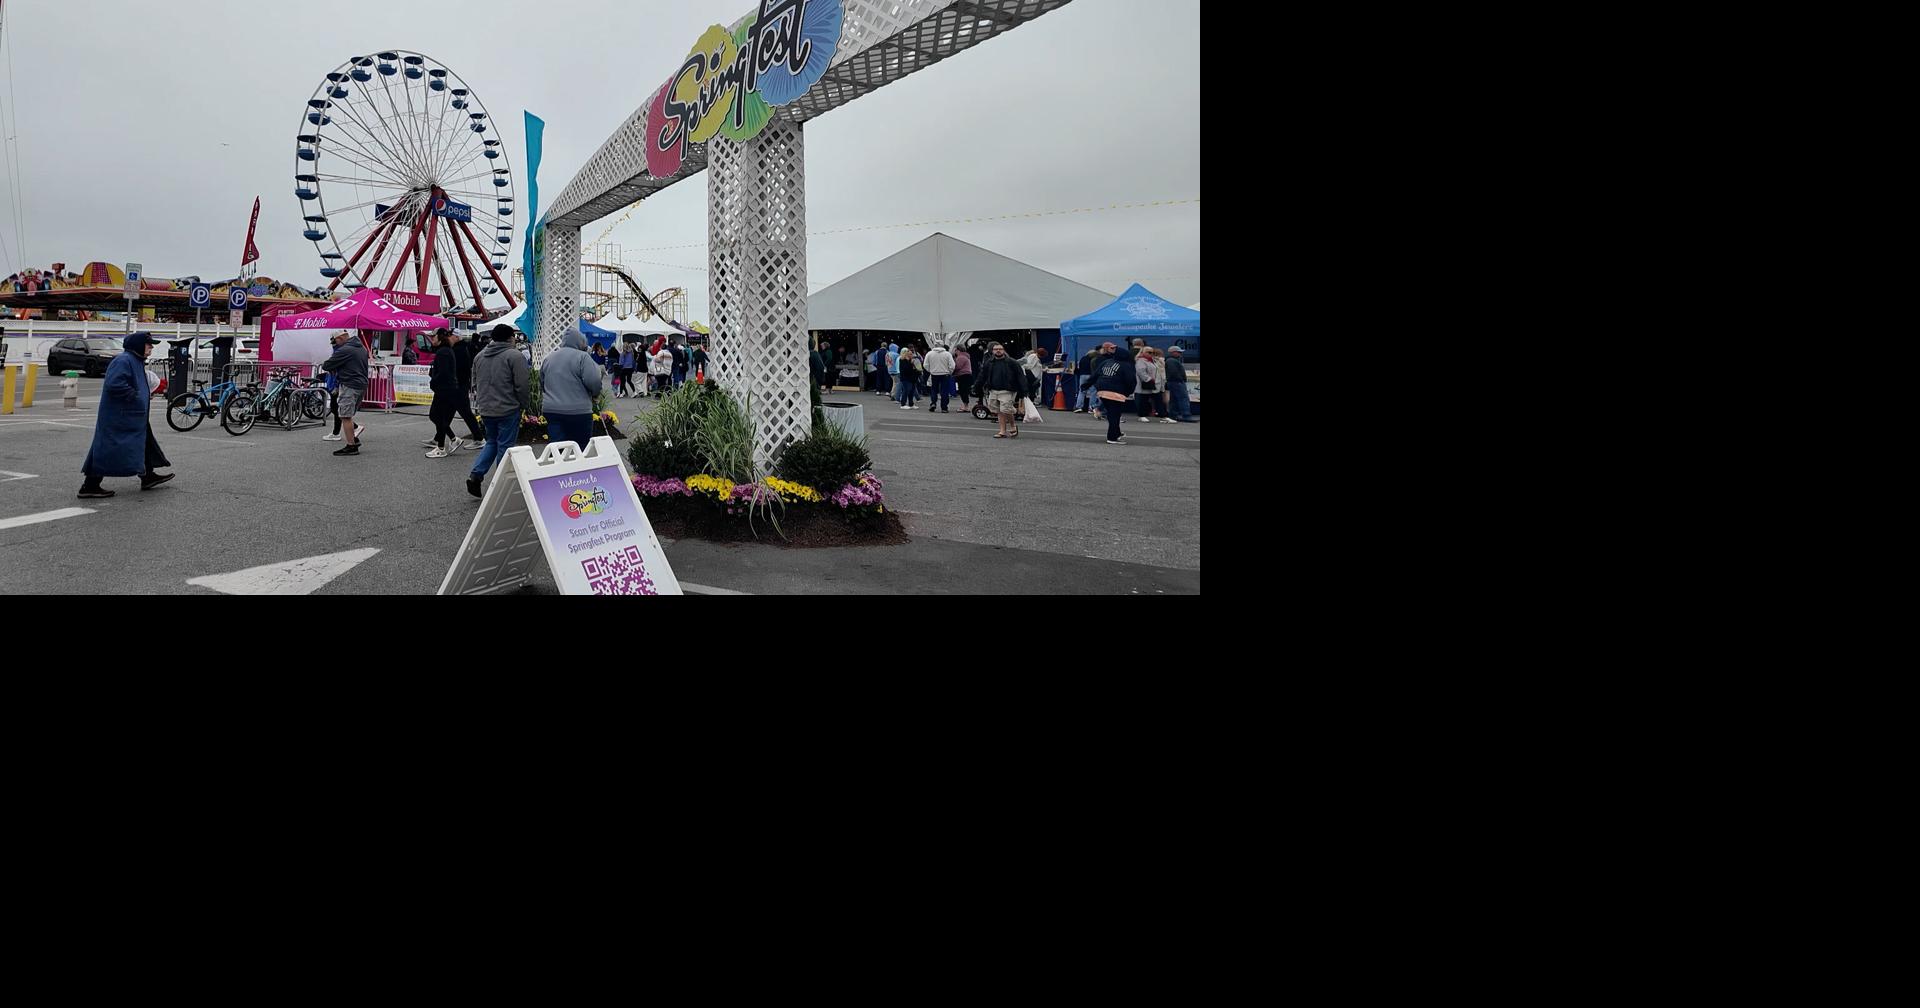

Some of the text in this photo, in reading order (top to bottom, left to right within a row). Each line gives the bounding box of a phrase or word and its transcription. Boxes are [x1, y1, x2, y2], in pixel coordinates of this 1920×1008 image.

[658, 0, 812, 162] Springfest
[448, 205, 470, 217] pepsi
[393, 294, 420, 306] Mobile
[301, 317, 328, 327] Mobile
[398, 318, 430, 328] Mobile
[559, 476, 589, 489] Welcome
[569, 487, 608, 514] Springfest
[569, 517, 625, 538] Scan for Official
[568, 529, 636, 553] Springfest Program
